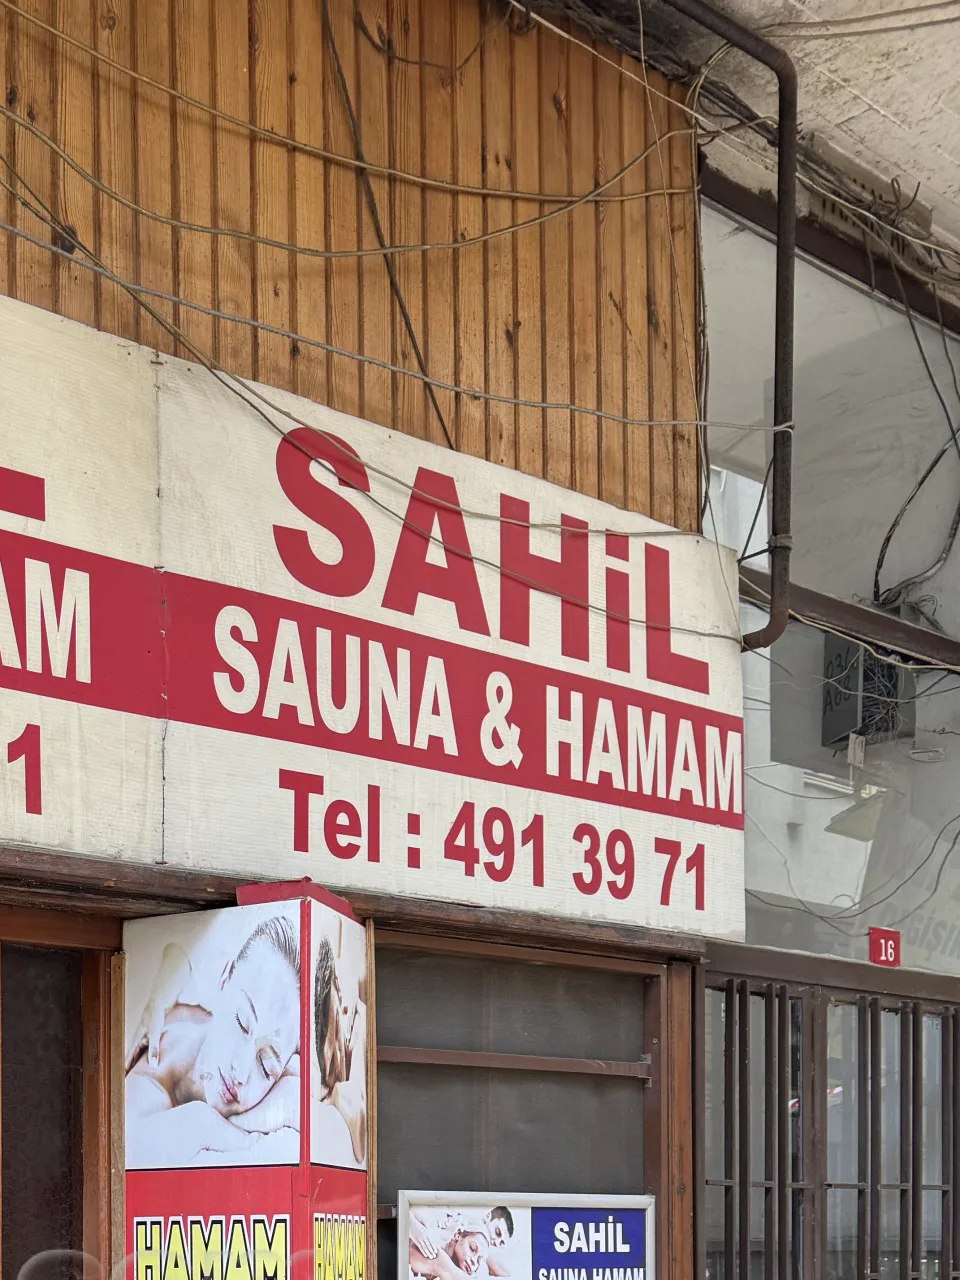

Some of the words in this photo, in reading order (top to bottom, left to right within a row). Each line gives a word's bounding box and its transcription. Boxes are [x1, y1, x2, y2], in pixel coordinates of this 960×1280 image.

[213, 606, 457, 758] SAUNA
[480, 671, 522, 769] &
[546, 684, 743, 814] HAMAM
[444, 801, 544, 887] 491
[572, 823, 635, 900] 39
[655, 838, 705, 911] 71
[880, 938, 895, 961] 16
[553, 1215, 630, 1253] SAHİL
